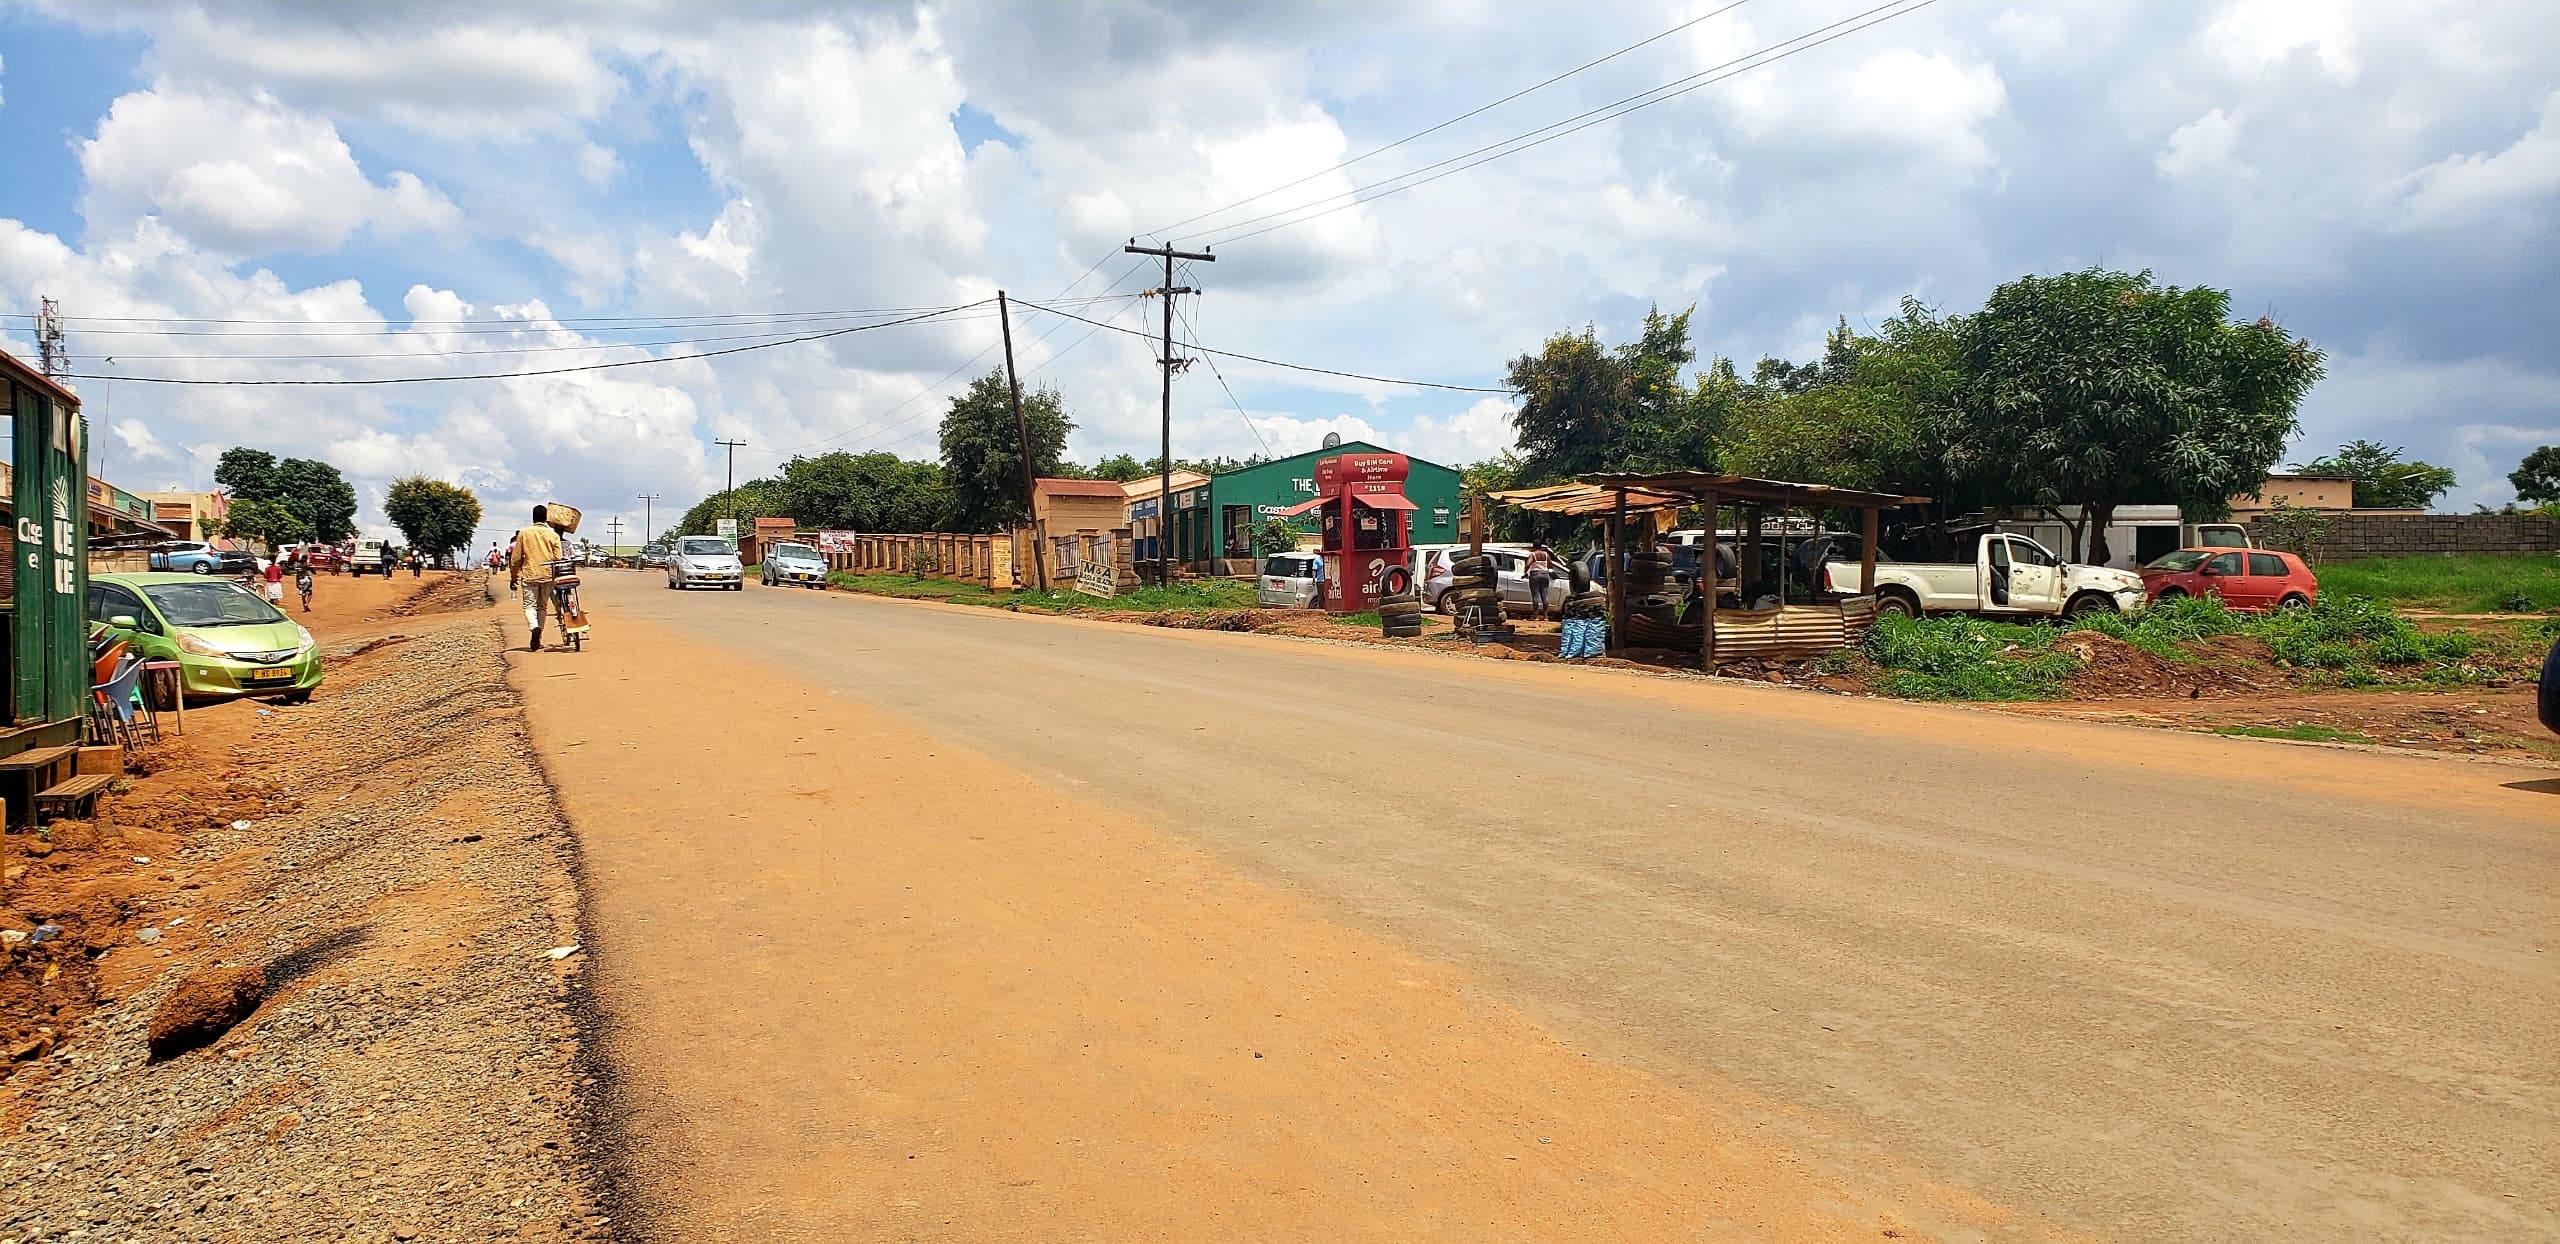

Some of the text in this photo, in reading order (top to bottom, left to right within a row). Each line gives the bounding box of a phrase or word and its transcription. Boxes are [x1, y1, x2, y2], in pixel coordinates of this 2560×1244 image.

[1292, 479, 1313, 492] THE
[1083, 562, 1096, 575] M
[1102, 567, 1112, 580] A
